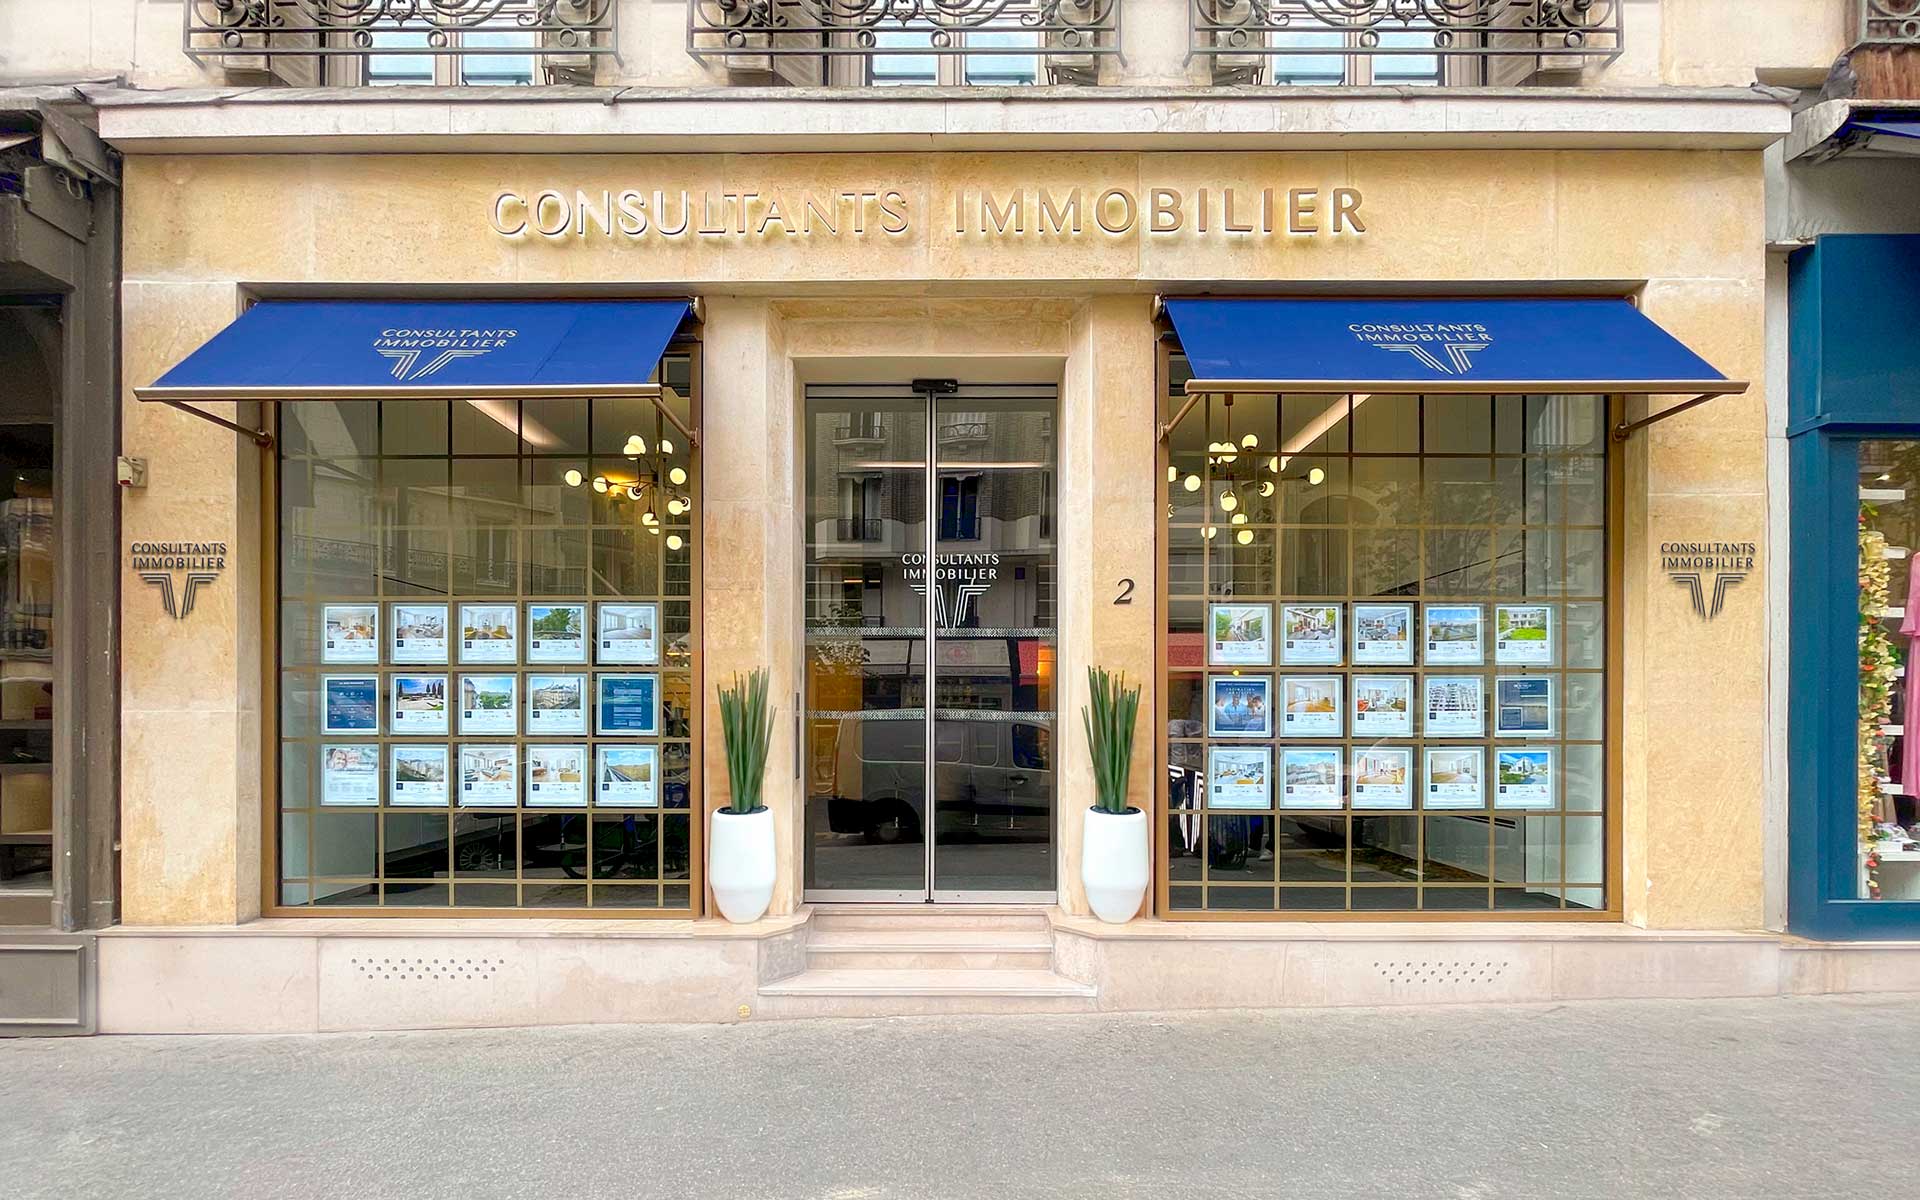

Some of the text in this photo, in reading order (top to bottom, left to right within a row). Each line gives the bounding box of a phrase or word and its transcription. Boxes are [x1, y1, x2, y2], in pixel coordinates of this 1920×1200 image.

[490, 188, 1367, 236] CONSULTANTS IMMOBILIER
[382, 328, 518, 338] CONSULTANTS
[1348, 323, 1487, 332] CONSULTANTS
[373, 338, 507, 348] IMMOBILIER
[1356, 333, 1493, 342] IMMOBILIER
[131, 542, 227, 554] CONSULTANTS
[1661, 542, 1756, 554] CONSULTANTS
[133, 557, 225, 569] IMMOBILIER
[1662, 557, 1754, 568] IMMOBILIER
[1113, 578, 1135, 605] 2
